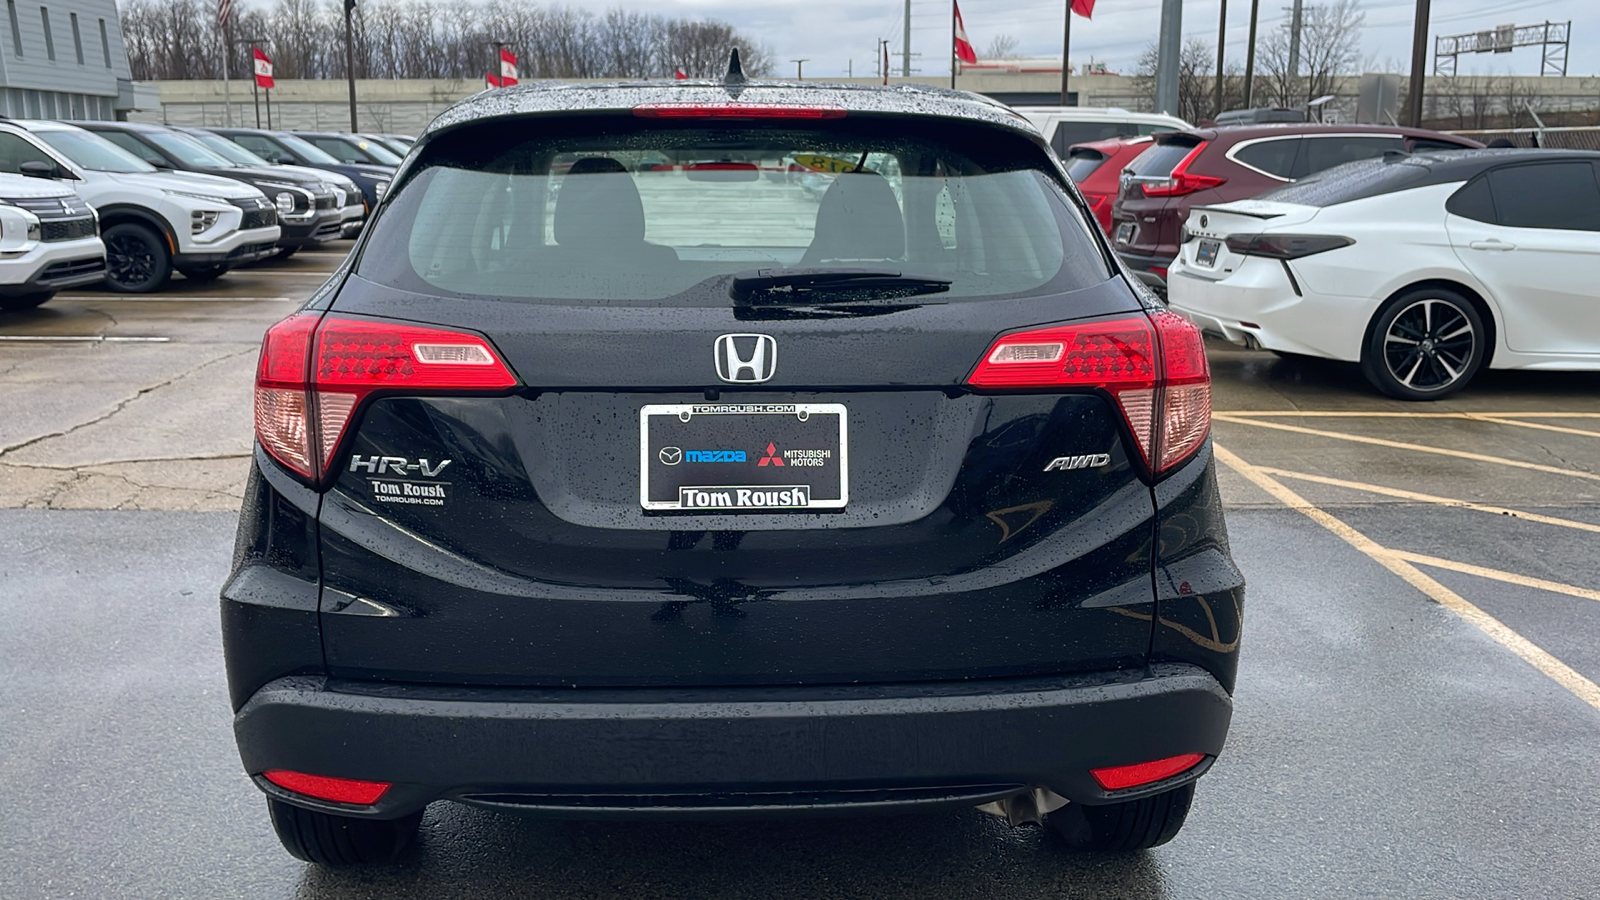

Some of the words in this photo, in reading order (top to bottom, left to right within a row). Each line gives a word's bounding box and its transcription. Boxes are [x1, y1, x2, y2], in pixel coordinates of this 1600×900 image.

[693, 405, 796, 413] TOMROUSH.COM
[685, 450, 747, 462] mazda
[784, 450, 831, 459] MITSUBISHI
[349, 454, 452, 477] HR-V
[790, 458, 824, 467] MOTORS
[1043, 453, 1111, 472] AWD
[371, 481, 401, 495] Tom
[402, 483, 446, 498] Roush
[375, 495, 444, 506] TOMROUSH.COM
[683, 489, 733, 507] Tom
[736, 488, 808, 507] Roush
